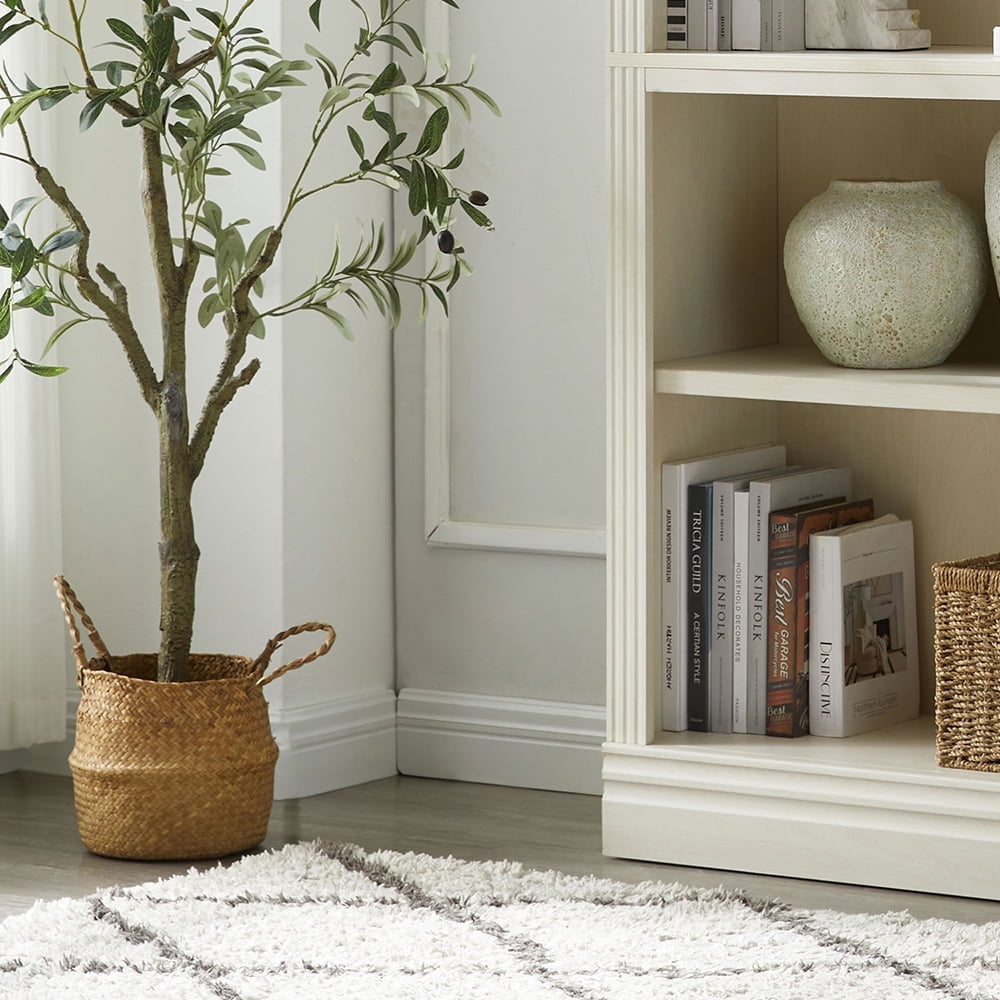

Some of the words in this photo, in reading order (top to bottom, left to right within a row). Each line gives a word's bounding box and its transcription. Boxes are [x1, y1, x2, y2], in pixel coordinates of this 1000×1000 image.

[691, 509, 702, 551] TRICIA
[691, 554, 702, 594] GUILD
[775, 571, 793, 626] Best
[717, 574, 726, 640] KINFOLK
[753, 574, 763, 641] KINFOLK
[693, 657, 701, 684] STYLE
[779, 629, 789, 679] GARAGE
